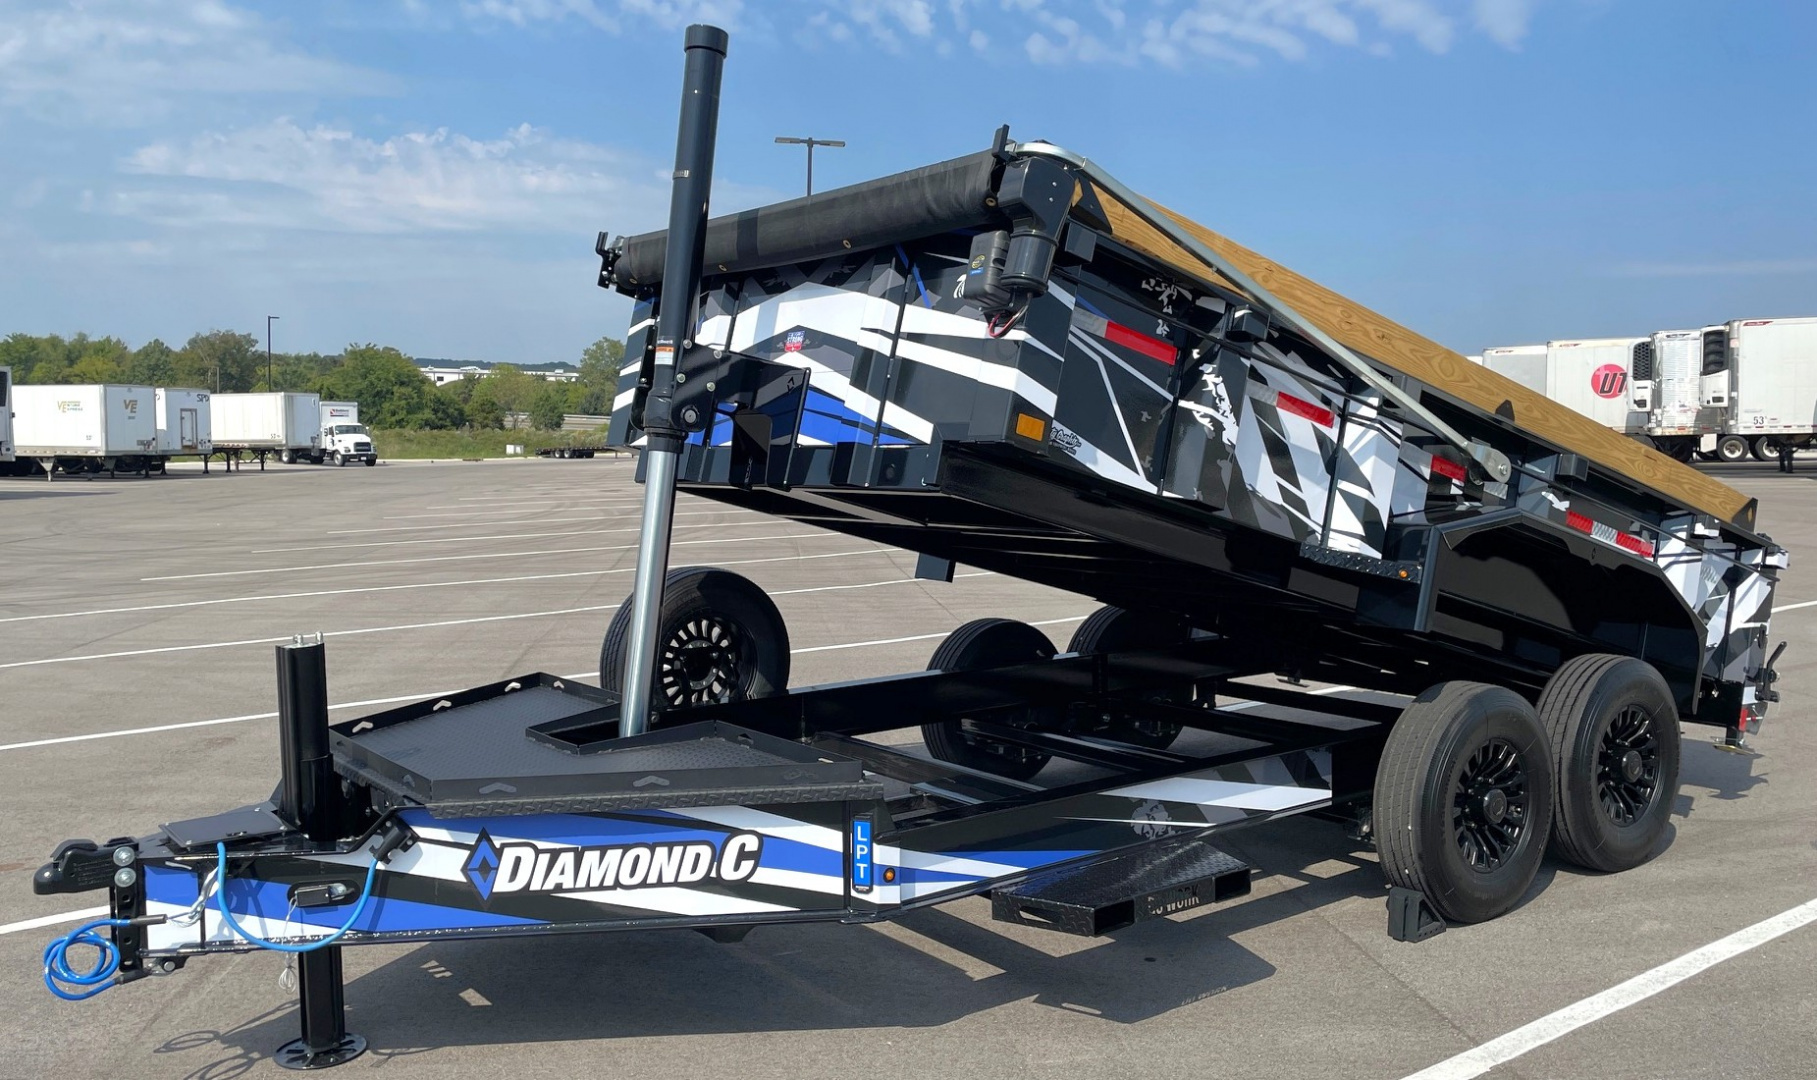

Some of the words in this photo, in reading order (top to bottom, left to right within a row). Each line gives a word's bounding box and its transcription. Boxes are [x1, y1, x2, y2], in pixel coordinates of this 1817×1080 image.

[123, 400, 138, 414] VE
[492, 843, 713, 893] DIAMOND
[856, 825, 869, 879] LPT
